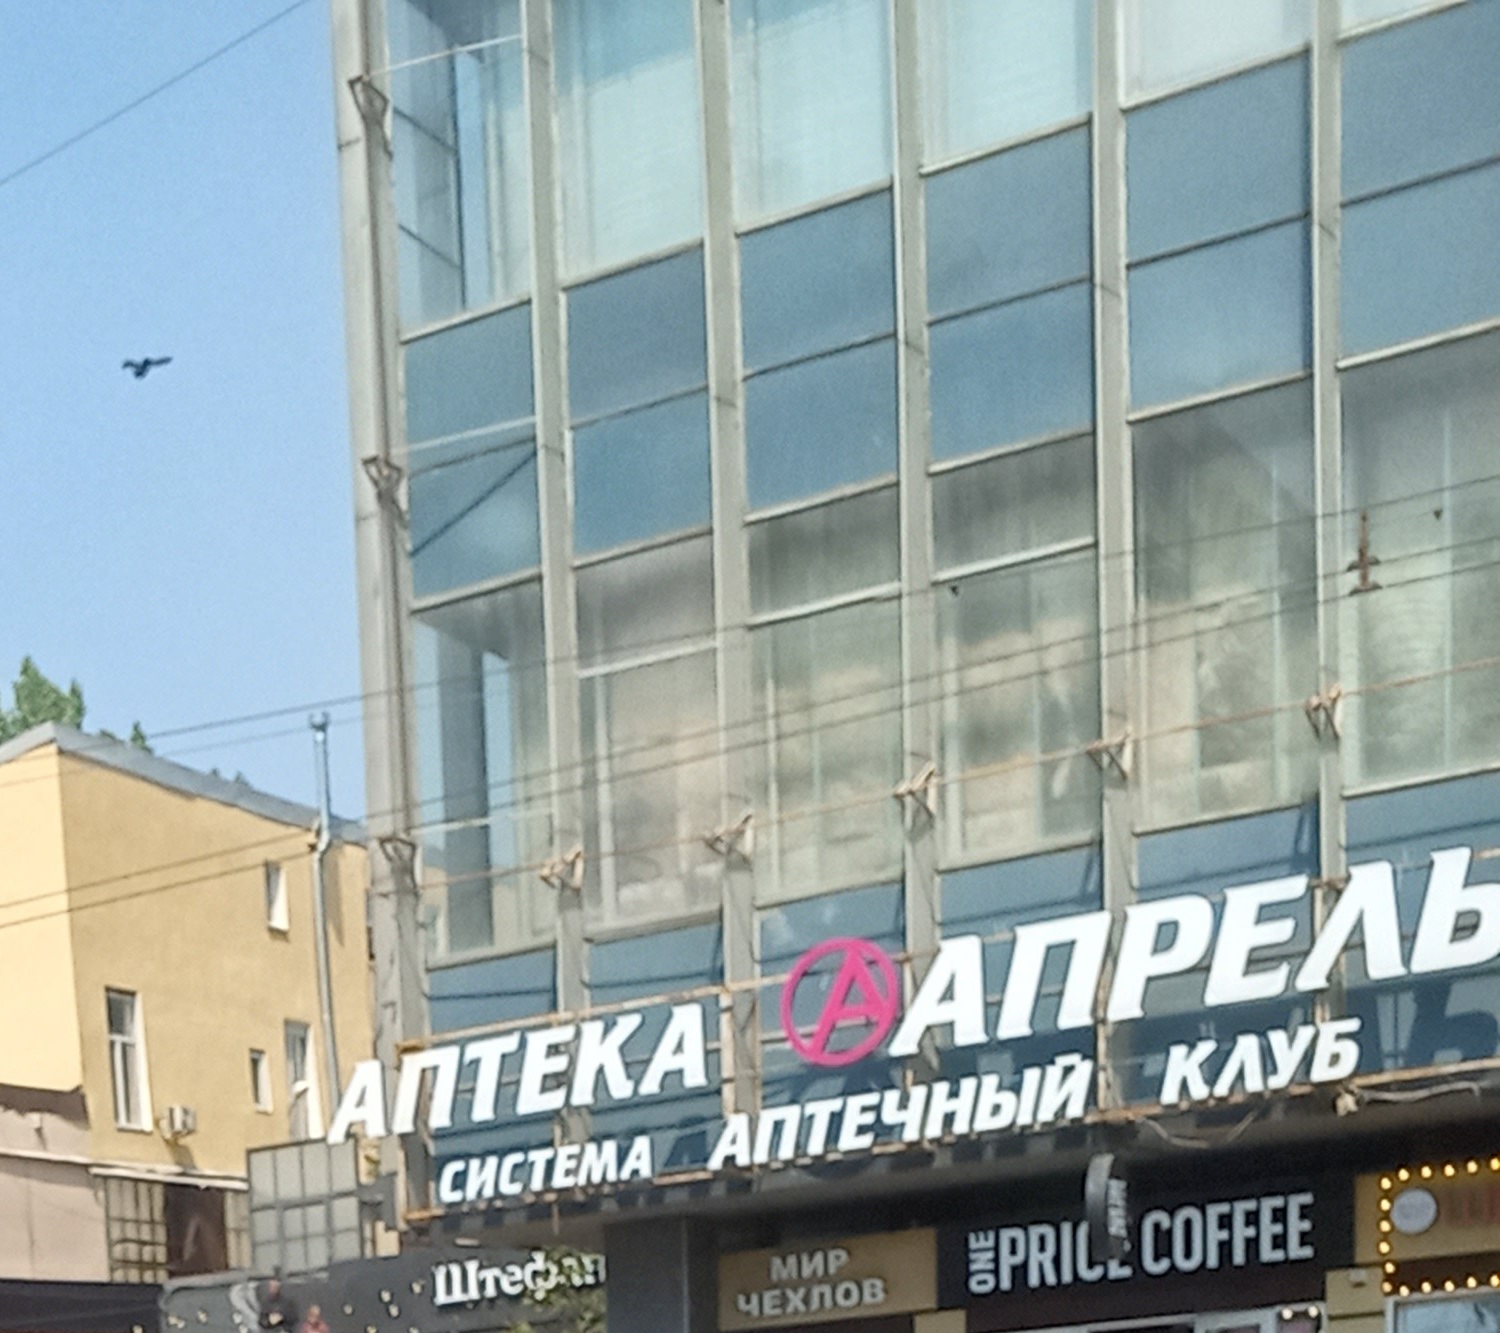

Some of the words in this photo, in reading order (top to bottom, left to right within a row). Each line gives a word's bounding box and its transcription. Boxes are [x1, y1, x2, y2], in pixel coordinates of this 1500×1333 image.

[327, 1001, 708, 1145] АПТЕКА
[888, 846, 1500, 1058] АПРЕЛЬ
[438, 1135, 653, 1205] СИСТЕМА
[706, 1053, 1095, 1171] АПТЕЧНЫЙ
[1159, 1016, 1363, 1105] КЛУБ
[769, 1247, 851, 1283] МИР
[967, 1229, 996, 1295] ONE
[1140, 1191, 1315, 1276] COFFEE
[736, 1277, 887, 1318] ЧЕХЛОВ
